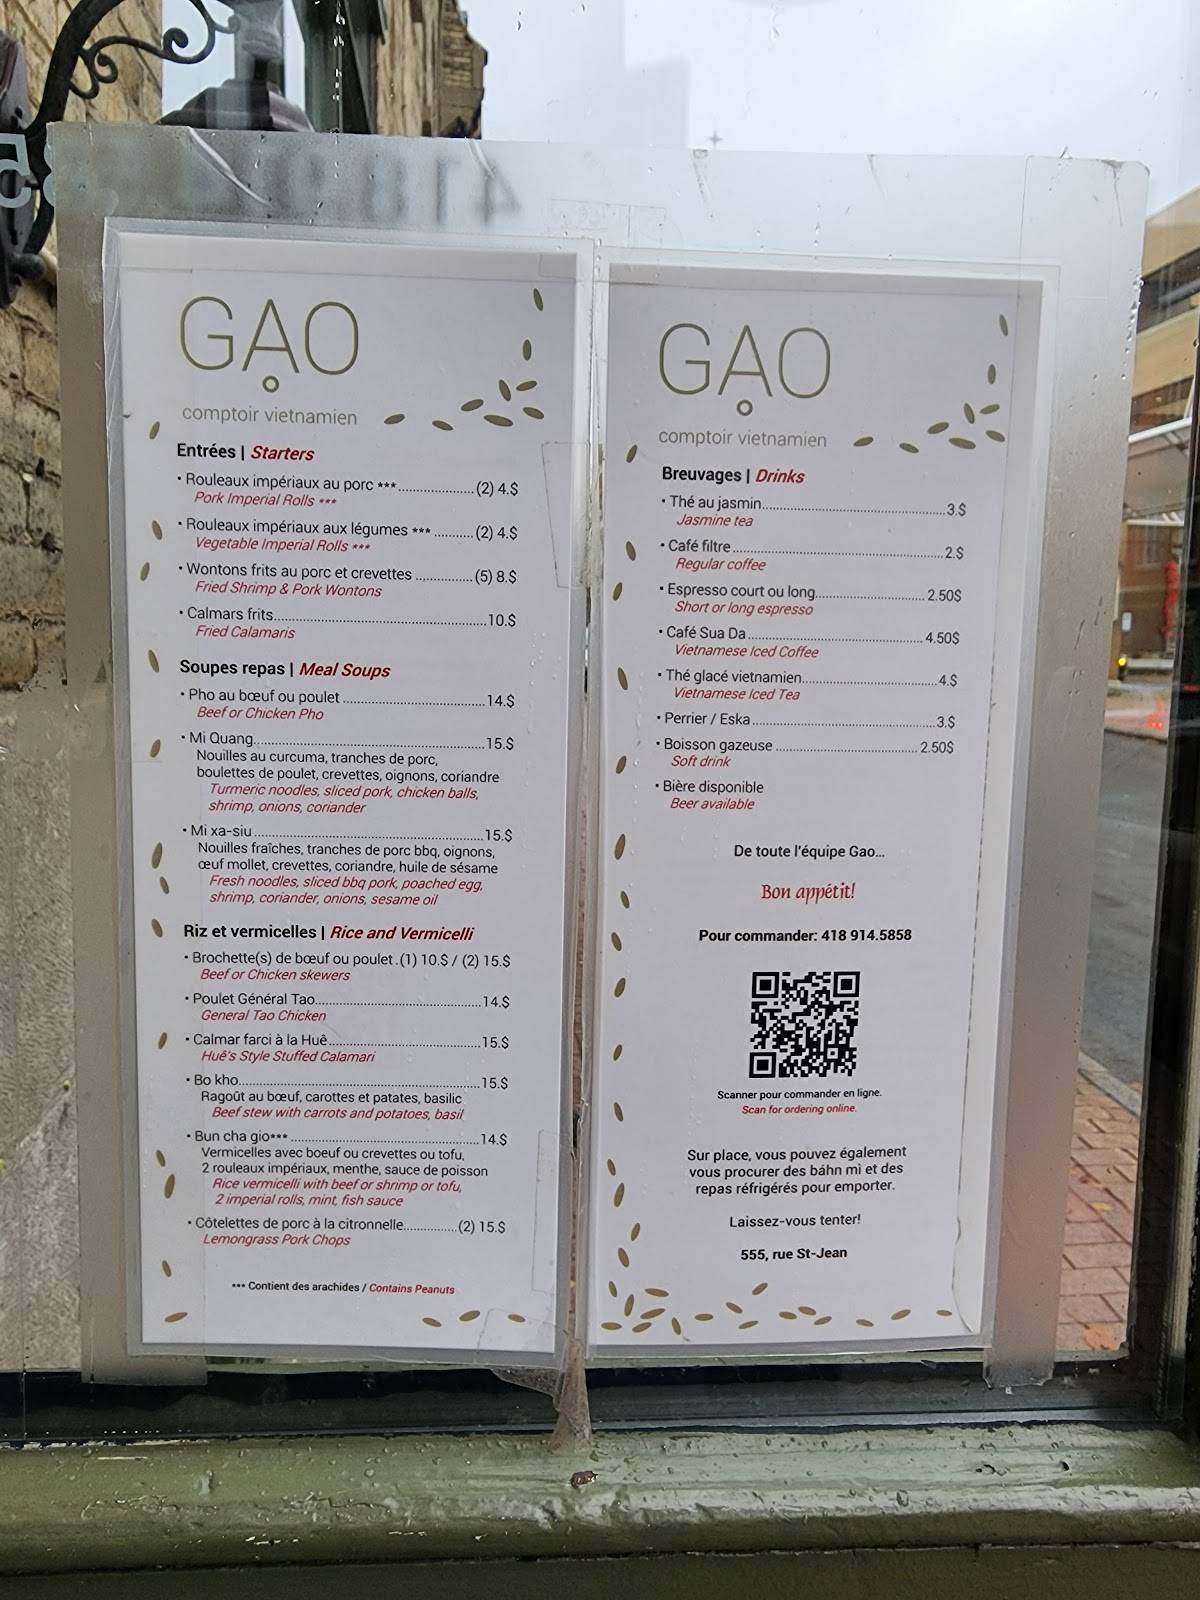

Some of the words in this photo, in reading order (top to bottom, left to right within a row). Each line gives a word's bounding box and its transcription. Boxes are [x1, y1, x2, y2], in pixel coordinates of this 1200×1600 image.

[182, 405, 260, 425] comptoir
[264, 406, 357, 426] vietnamien
[658, 429, 733, 448] comptoir
[738, 429, 827, 448] vietnamien
[177, 442, 237, 459] Entrées
[250, 445, 315, 462] Starters
[662, 465, 743, 486] Breuvages
[755, 468, 806, 484] Drinks
[185, 471, 250, 487] Rouleaux
[253, 473, 320, 492] impériaux
[322, 479, 340, 491] au
[343, 480, 374, 493] porc
[476, 480, 495, 498] (2)
[669, 494, 695, 509] Thé
[697, 498, 715, 509] au
[186, 517, 250, 533] Rouleaux
[253, 518, 320, 536] impériaux
[322, 523, 348, 535] aux
[350, 521, 409, 539] légumes
[475, 524, 494, 542] (2)
[668, 538, 700, 553] Café
[186, 562, 248, 577] Wontons
[280, 567, 298, 578] au
[301, 567, 332, 581] porc
[334, 567, 348, 579] et
[350, 568, 413, 581] crevettes
[474, 568, 493, 586] (5)
[667, 582, 728, 599] Espresso
[730, 585, 765, 598] court
[767, 587, 785, 598] ou
[187, 606, 244, 621] Calmars
[666, 624, 697, 639] Café
[699, 626, 725, 640] Sua
[675, 642, 748, 657] Vietnamese
[749, 645, 778, 658] Iced
[778, 645, 820, 659] Coffee
[179, 659, 238, 678] Soupes
[242, 663, 286, 679] repas
[298, 661, 340, 677] Meal
[340, 662, 392, 681] Soups
[665, 668, 691, 682] Thé
[693, 668, 729, 686] glacé
[188, 687, 216, 702] Pho
[218, 691, 236, 702] au
[238, 688, 276, 703] bœuf
[277, 692, 295, 703] ou
[298, 689, 341, 706] poulet
[664, 711, 708, 725] Perrier
[189, 730, 207, 744] Mi
[664, 736, 716, 751] Boisson
[719, 740, 773, 754] gazeuse
[191, 823, 208, 837] Mi
[760, 884, 791, 900] Bon
[183, 923, 209, 938] Riz
[211, 925, 228, 938] et
[229, 923, 317, 939] vermicelles
[329, 924, 364, 940] Rice
[366, 925, 398, 940] and
[401, 926, 475, 941] Vermicelli
[698, 929, 732, 942] Pour
[820, 929, 847, 942] 418
[849, 928, 913, 942] 914.5858
[192, 950, 273, 967] Brochette(s)
[275, 951, 294, 965] de
[294, 951, 331, 965] bœuf
[332, 955, 350, 965] ou
[352, 952, 394, 968] poulet
[399, 952, 418, 969] (1)
[461, 953, 479, 970] (2)
[193, 991, 236, 1005] Poulet
[237, 992, 288, 1006] Général
[193, 1032, 241, 1046] Calmar
[243, 1032, 272, 1046] farci
[274, 1032, 284, 1046] à
[286, 1033, 298, 1046] la
[194, 1073, 212, 1086] Bo
[717, 1090, 758, 1100] Scanner
[758, 1090, 783, 1102] pour
[783, 1088, 842, 1099] commander
[842, 1090, 856, 1098] en
[741, 1105, 767, 1115] Scan
[768, 1104, 784, 1114] for
[783, 1103, 825, 1116] ordering
[194, 1130, 221, 1143] Bun
[222, 1129, 247, 1143] cha
[687, 1149, 711, 1162] Sur
[754, 1151, 787, 1161] vous
[789, 1149, 837, 1164] pouvez
[839, 1145, 907, 1162] également
[195, 1216, 260, 1229] Côtelettes
[262, 1216, 279, 1230] de
[281, 1219, 311, 1232] porc
[312, 1216, 321, 1230] à
[324, 1217, 336, 1230] la
[458, 1219, 476, 1236] (2)
[729, 1215, 817, 1228] Laissez-vous
[202, 1233, 280, 1248] Lemongrass
[281, 1233, 311, 1246] Pork
[311, 1233, 352, 1248] Chops
[771, 1250, 794, 1260] rue
[796, 1247, 848, 1260] St-Jean
[247, 1280, 290, 1291] Contient
[291, 1281, 310, 1292] des
[311, 1281, 361, 1292] arachides
[368, 1282, 413, 1294] Contains
[414, 1283, 455, 1295] Peanuts
